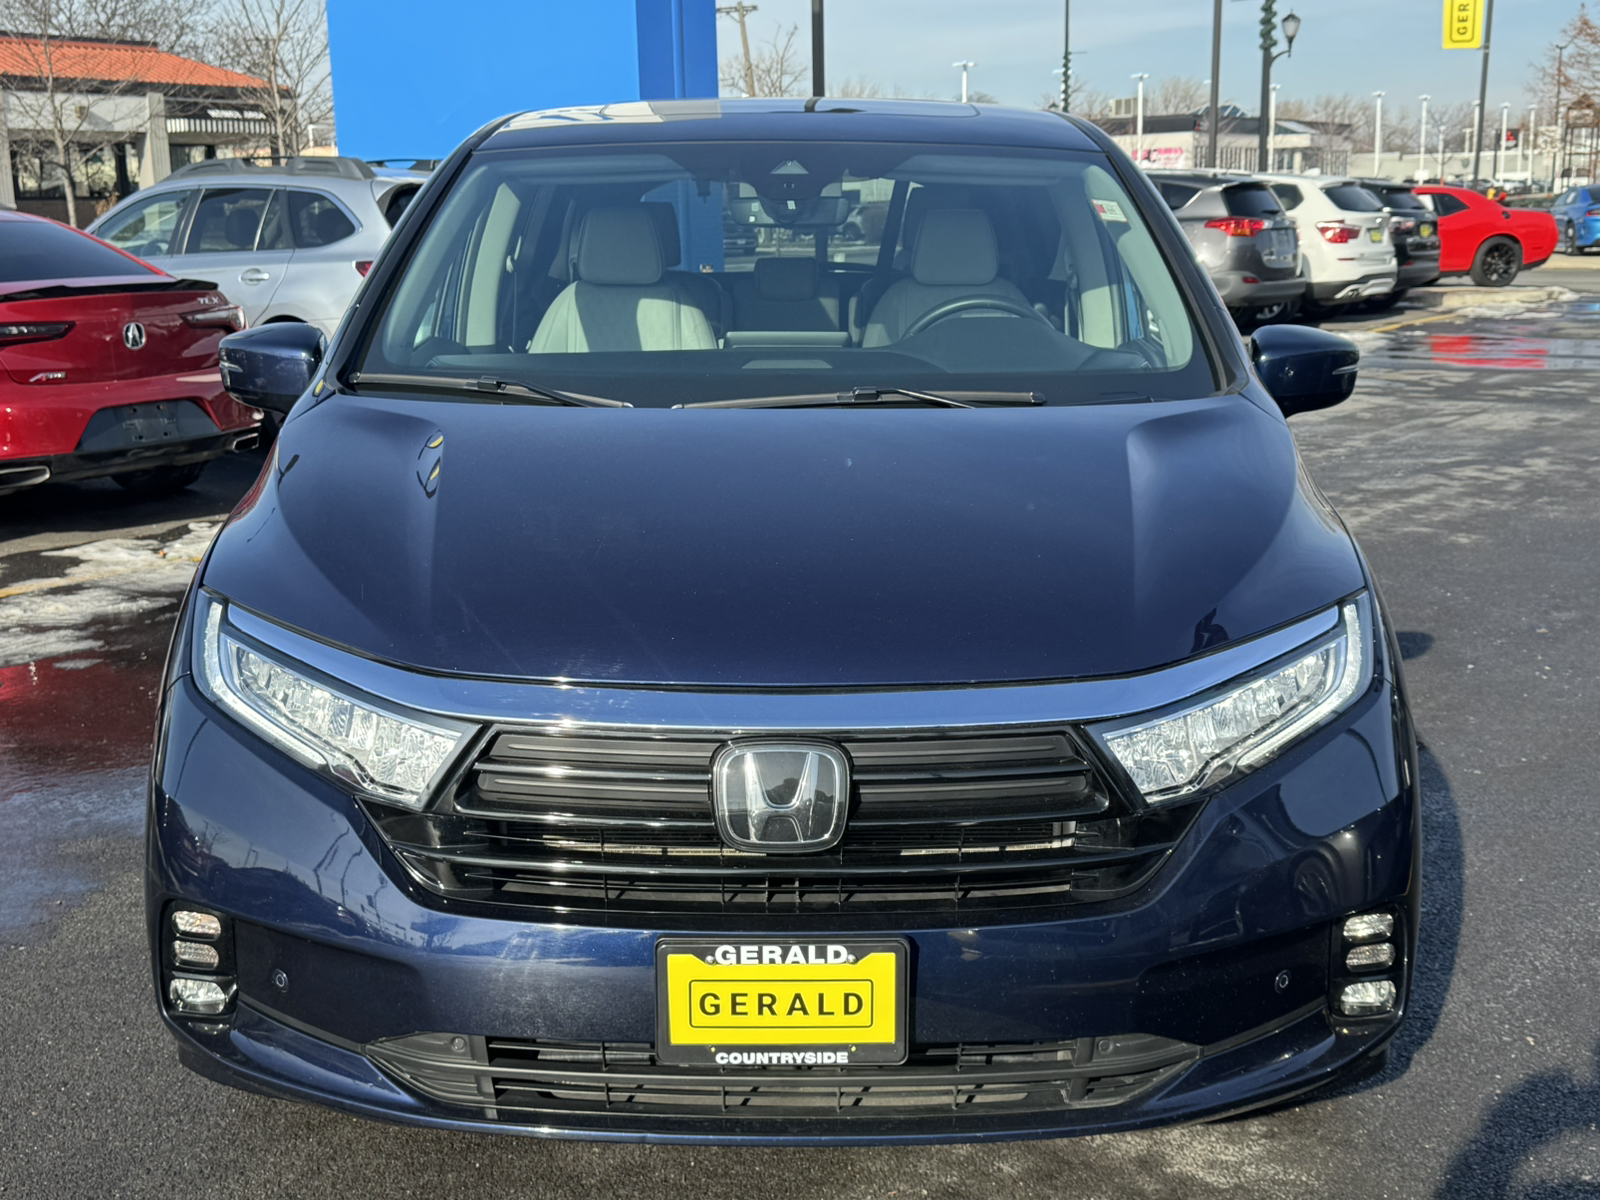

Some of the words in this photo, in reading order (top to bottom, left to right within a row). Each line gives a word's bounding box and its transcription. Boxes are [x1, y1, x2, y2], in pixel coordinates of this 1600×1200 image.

[714, 944, 848, 966] GERALD
[699, 992, 864, 1016] GERALD
[715, 1052, 849, 1065] COUNTRYSIDE
